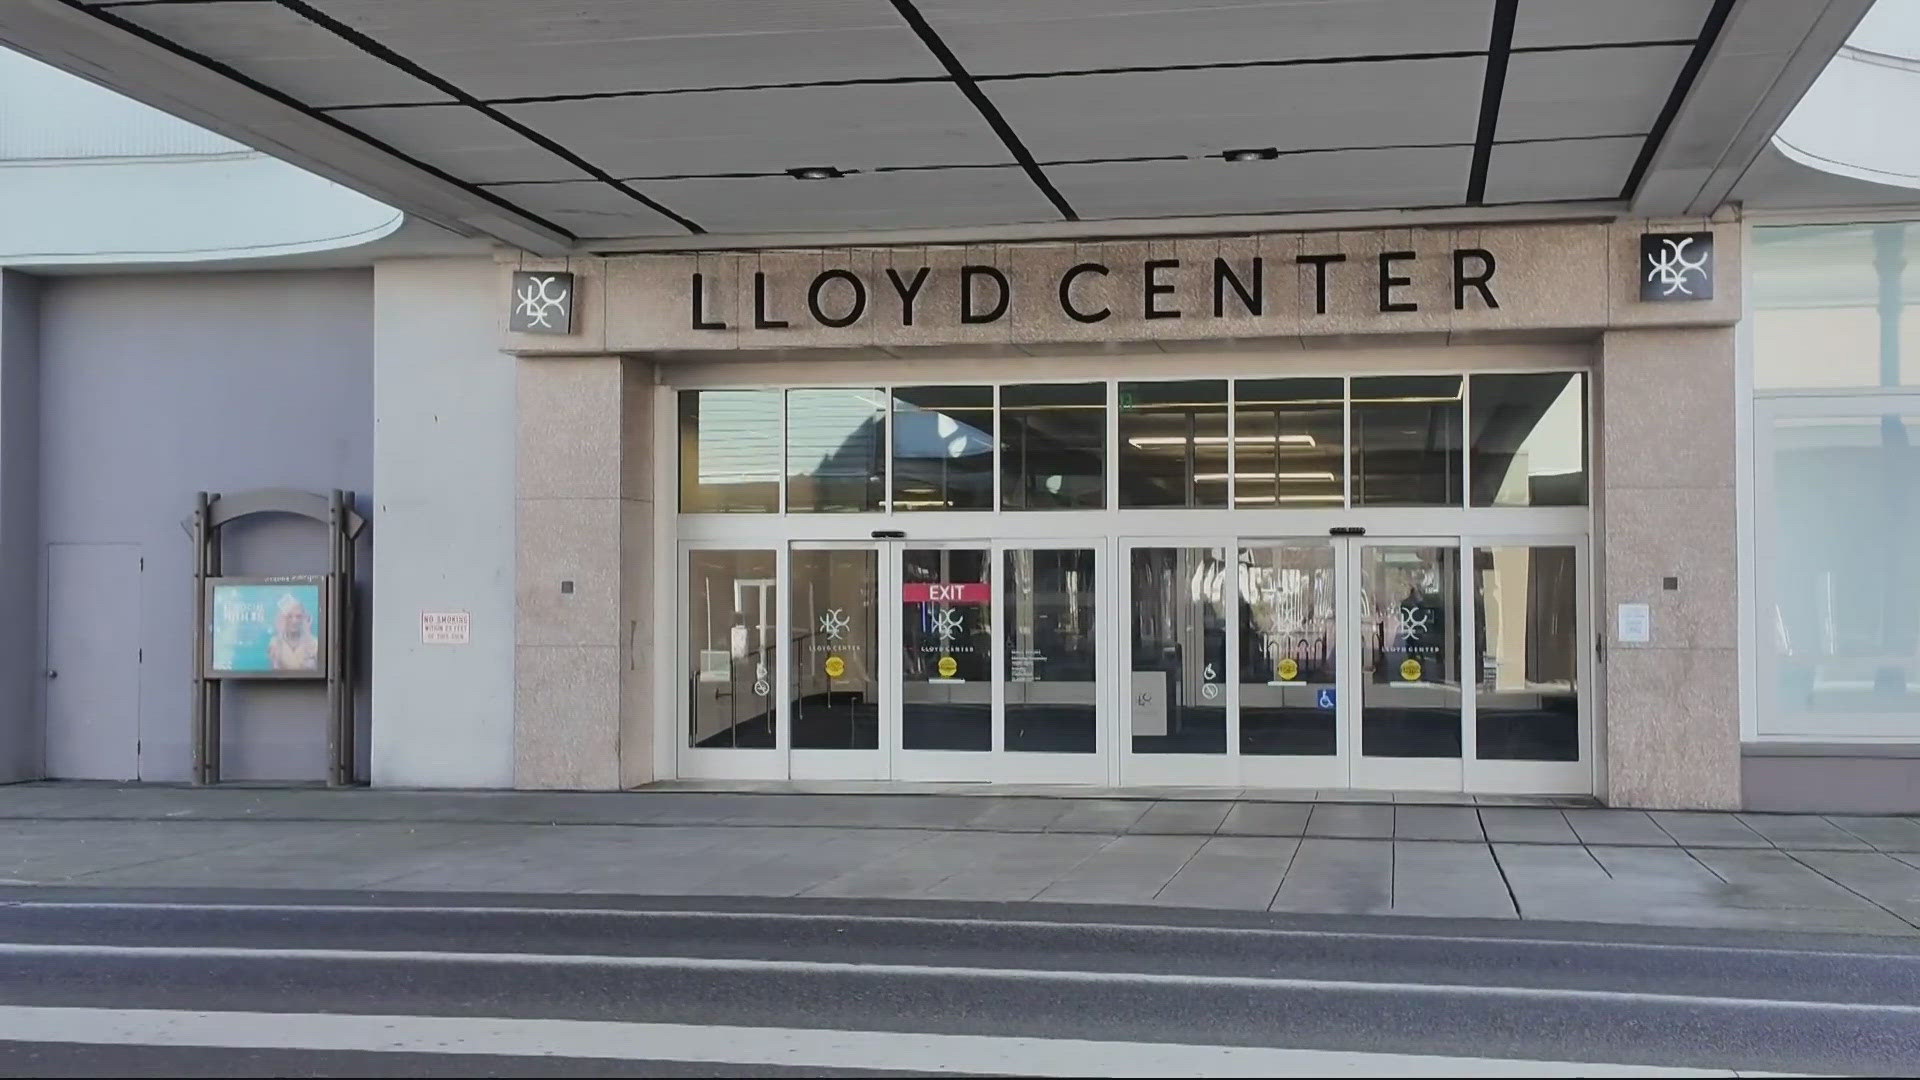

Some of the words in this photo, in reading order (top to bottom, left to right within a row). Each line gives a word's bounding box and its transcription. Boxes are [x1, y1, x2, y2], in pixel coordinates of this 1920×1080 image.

[691, 265, 1011, 331] LLOYD
[1058, 248, 1501, 324] CENTER
[929, 585, 965, 600] EXIT
[424, 615, 433, 624] NO
[437, 615, 468, 624] SMOKING
